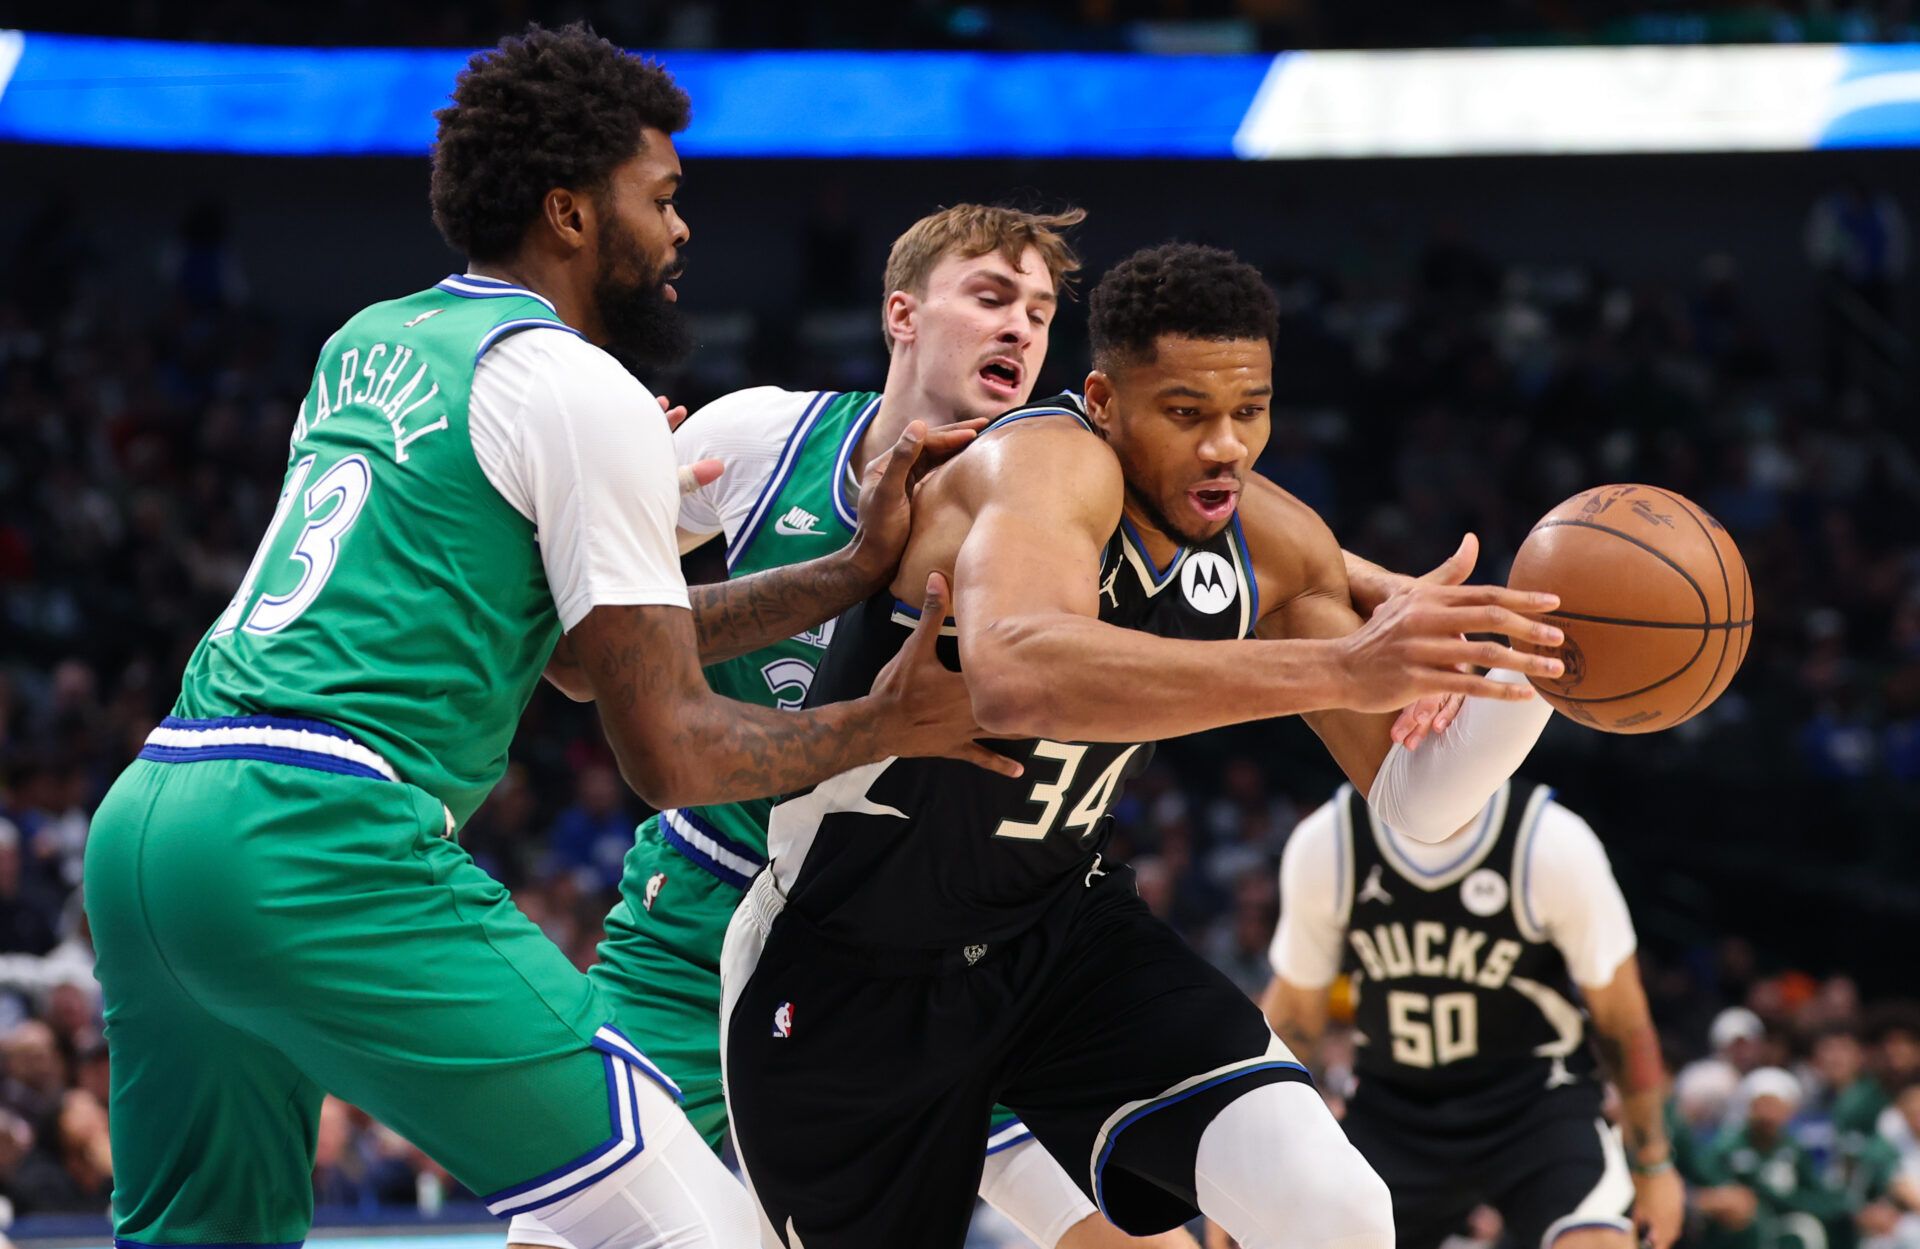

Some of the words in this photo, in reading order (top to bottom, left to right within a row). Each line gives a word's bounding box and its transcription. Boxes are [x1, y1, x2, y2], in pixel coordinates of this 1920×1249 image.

[208, 453, 371, 641] 13
[783, 505, 820, 531] NIKE
[991, 735, 1145, 841] 34
[1387, 990, 1479, 1069] 50
